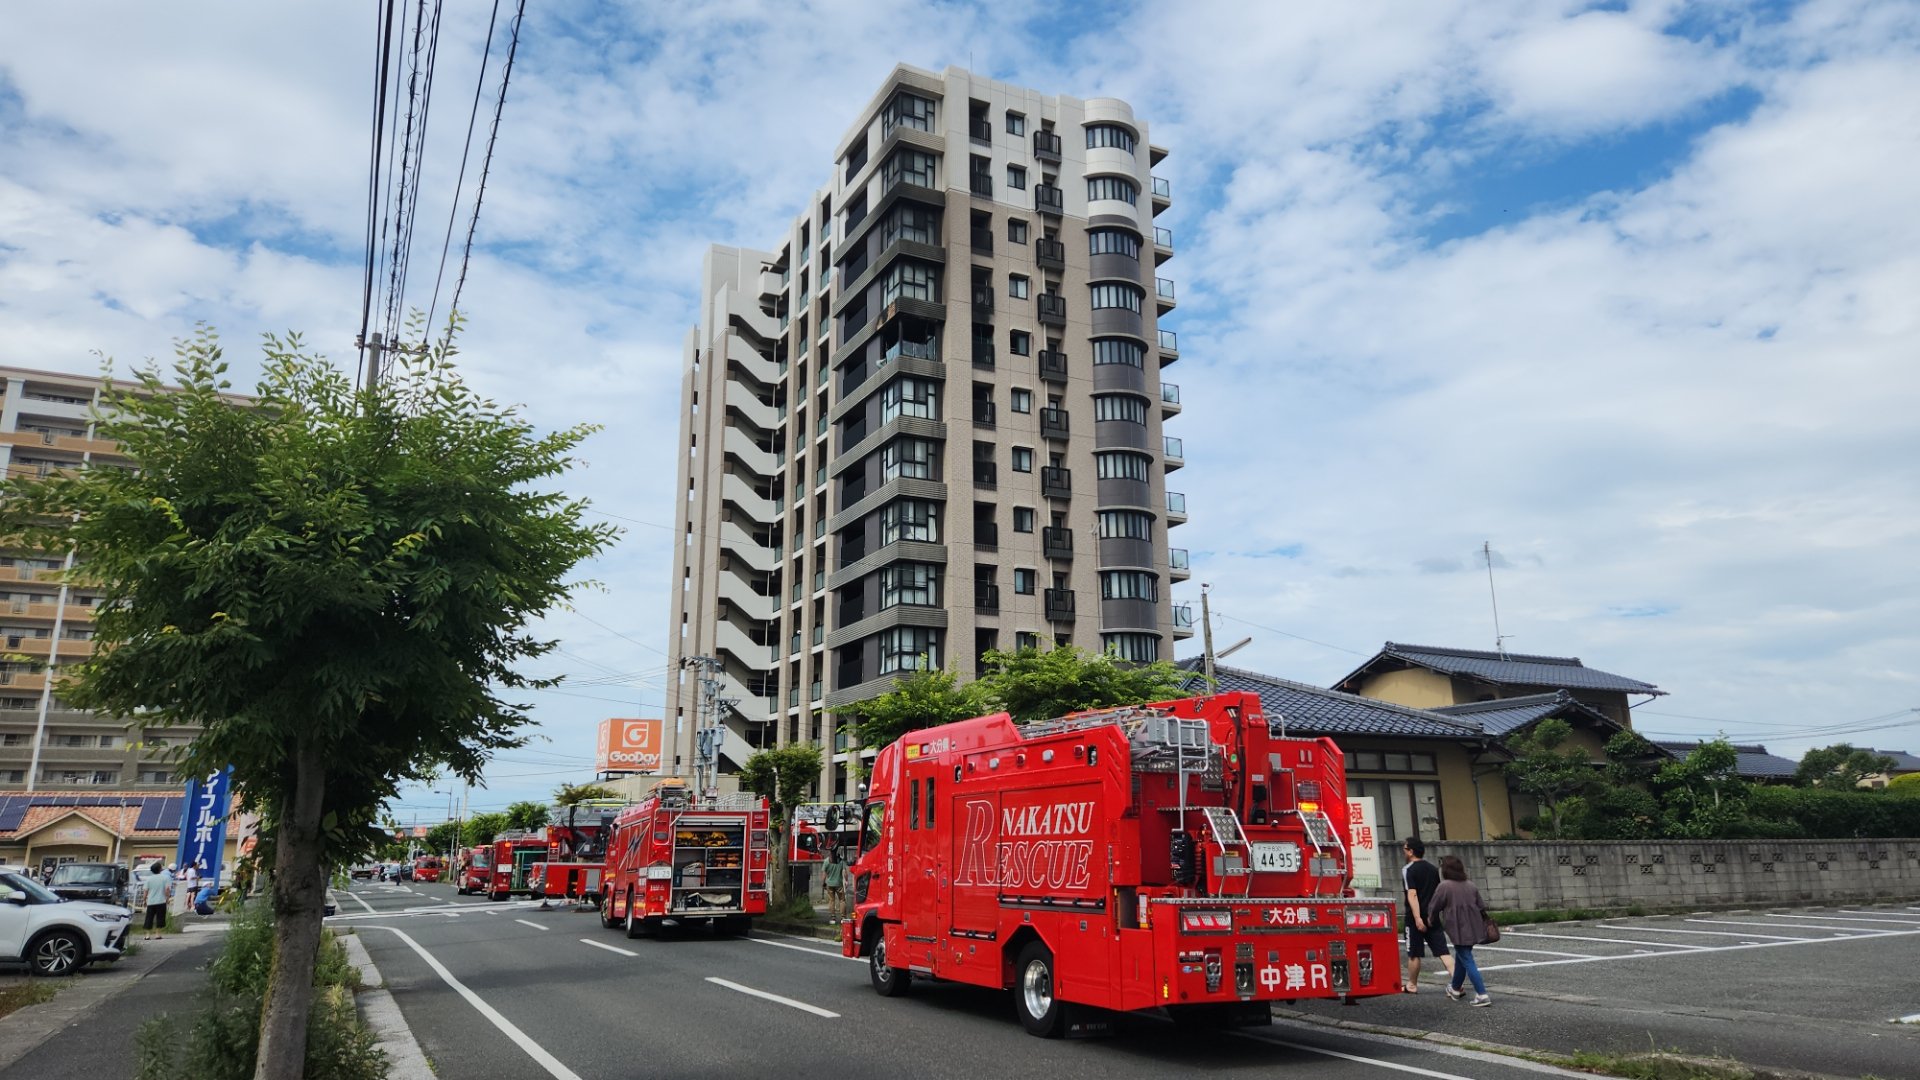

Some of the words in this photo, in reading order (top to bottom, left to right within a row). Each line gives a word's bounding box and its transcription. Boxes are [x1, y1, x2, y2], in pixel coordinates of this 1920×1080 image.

[610, 751, 660, 766] GooDay
[999, 802, 1095, 836] NAKATSU
[954, 800, 1094, 889] RESCUE
[1261, 852, 1293, 867] 44-95
[1269, 908, 1310, 924] 大分県
